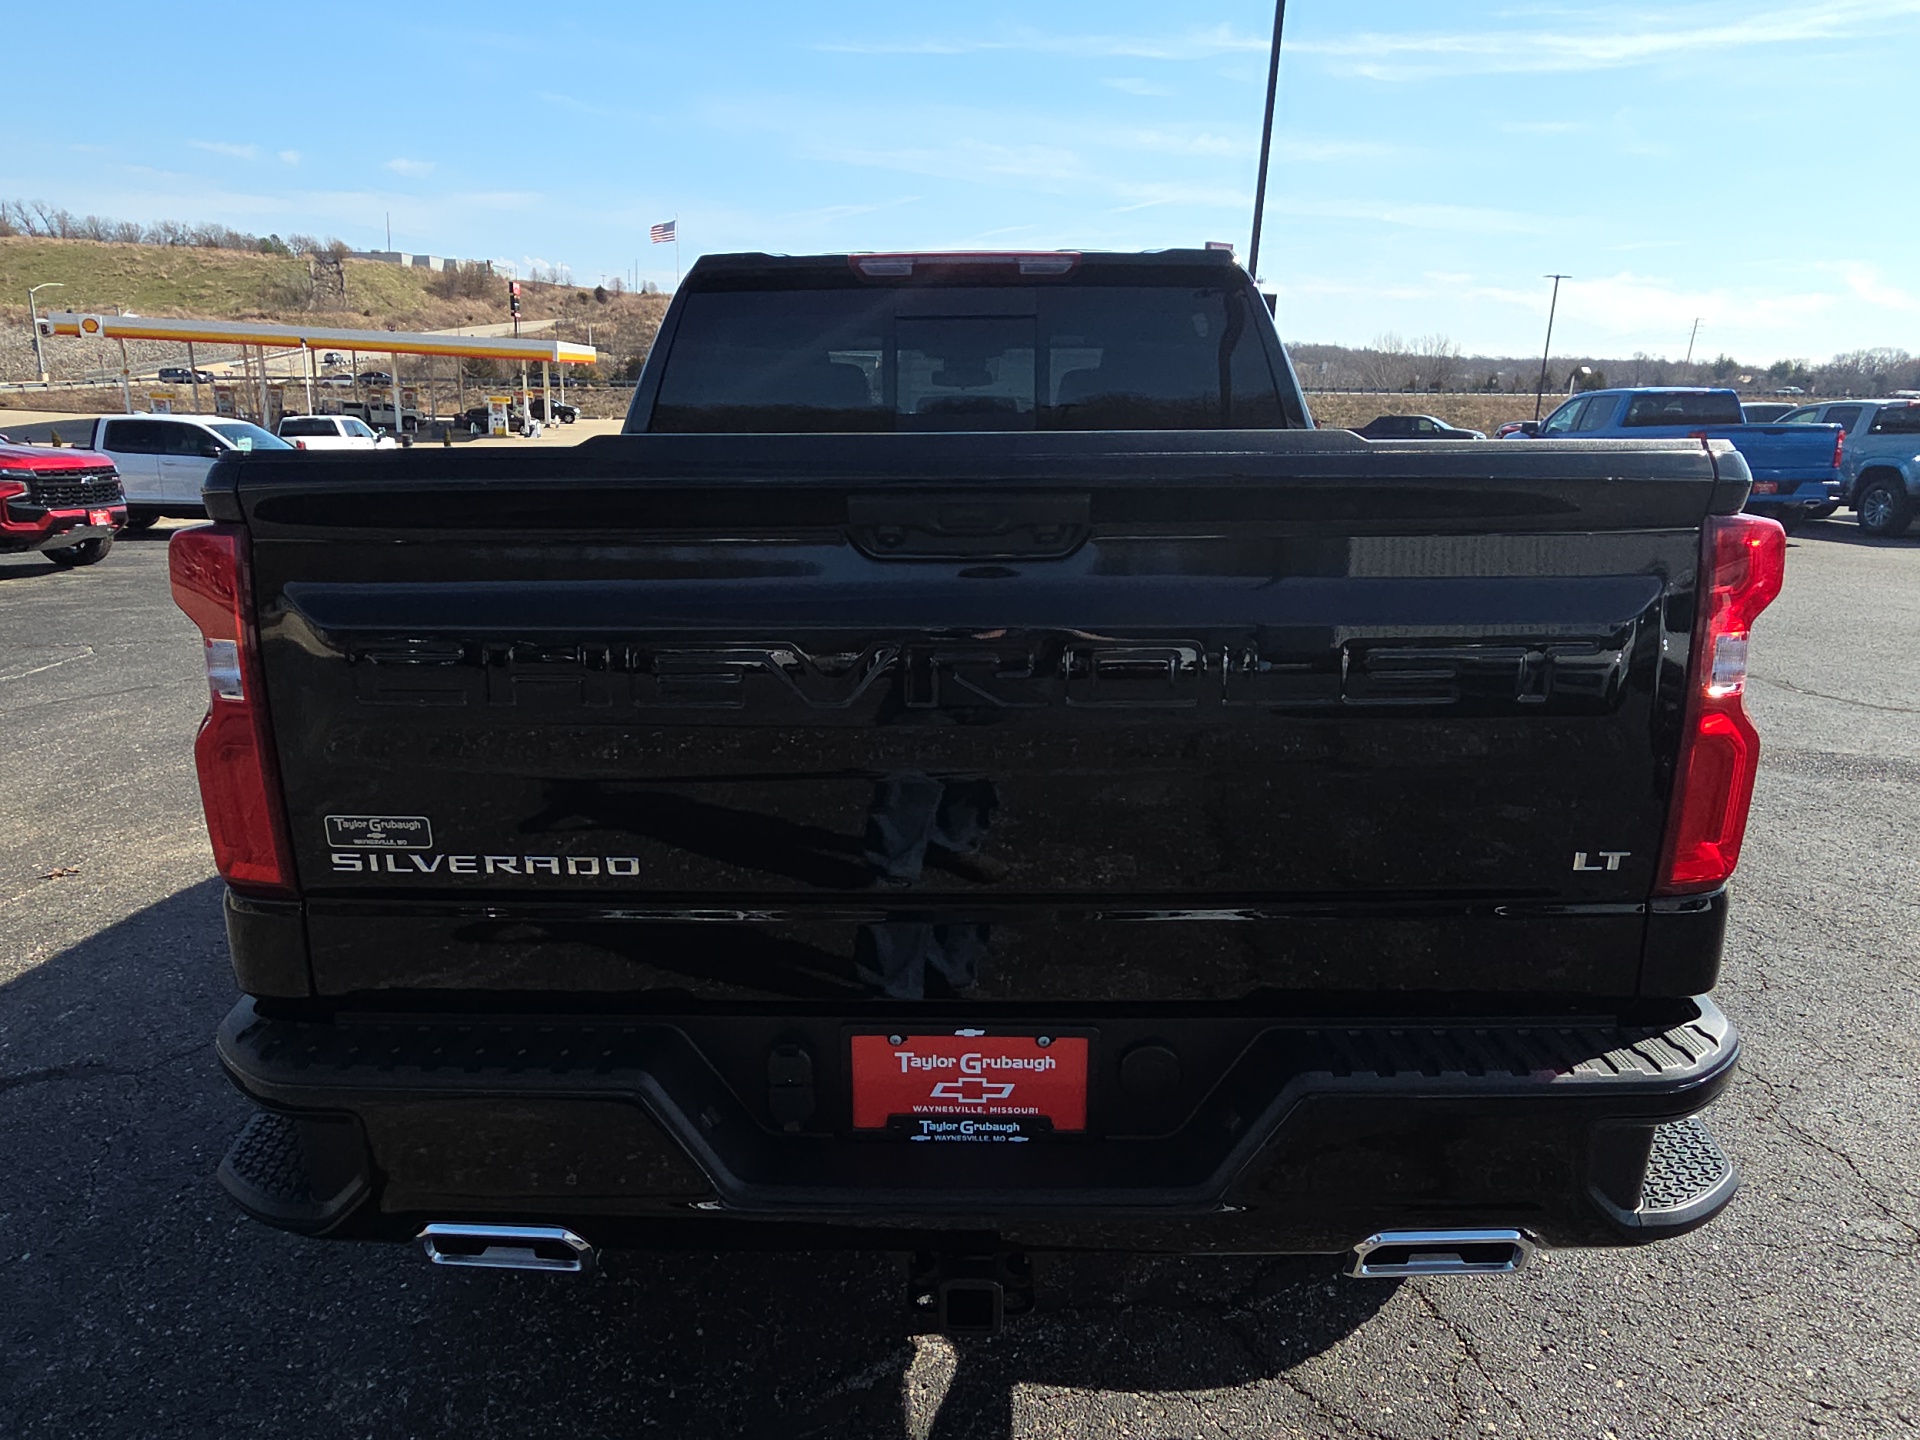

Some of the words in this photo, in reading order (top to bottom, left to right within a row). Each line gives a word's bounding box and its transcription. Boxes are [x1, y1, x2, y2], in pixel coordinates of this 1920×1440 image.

[333, 818, 368, 832] Taylor
[368, 819, 421, 832] Grubaugh
[330, 853, 640, 876] SILVERADO
[1572, 851, 1632, 871] LT
[894, 1052, 957, 1073] Taylor
[959, 1053, 1056, 1074] Grubaugh
[912, 1105, 987, 1115] WAYNESVILLE,
[989, 1106, 1039, 1115] MISSOURI
[919, 1120, 959, 1134] Taylor
[959, 1120, 1020, 1134] Grubaugh
[934, 1134, 991, 1143] WAYNESVILLE,
[992, 1135, 1006, 1143] MO
